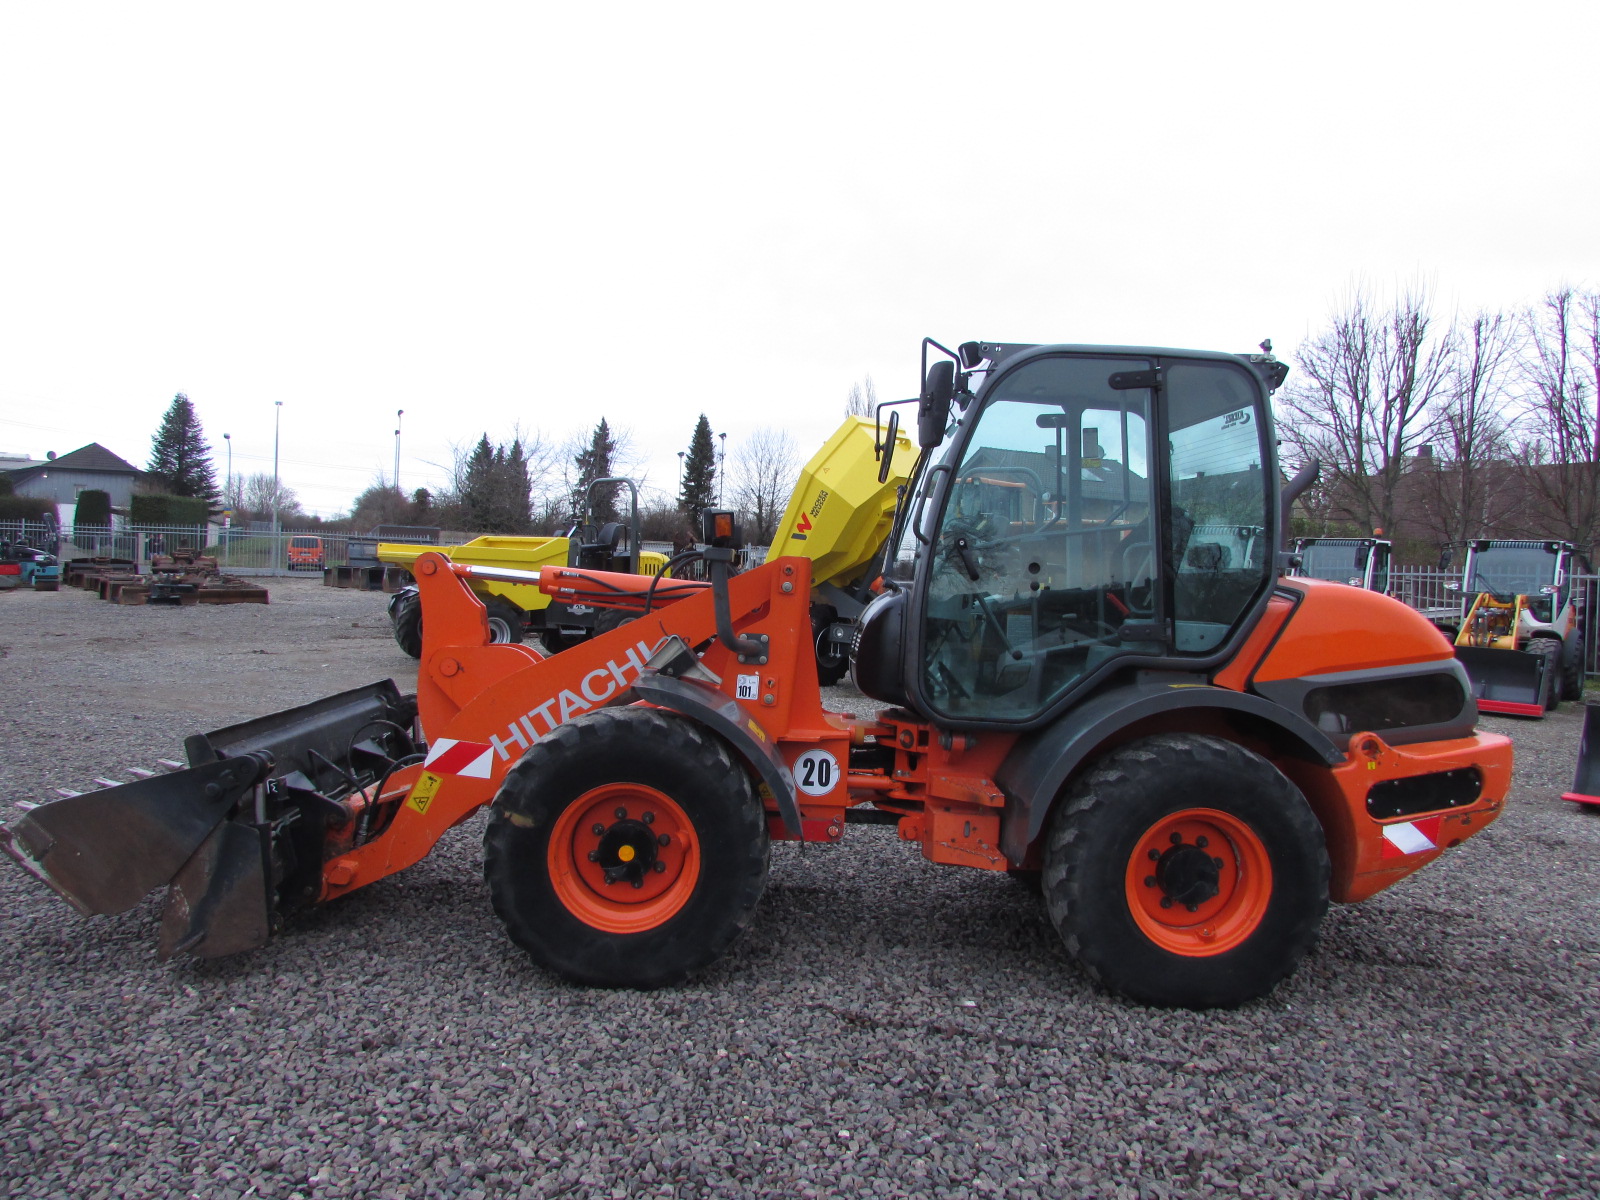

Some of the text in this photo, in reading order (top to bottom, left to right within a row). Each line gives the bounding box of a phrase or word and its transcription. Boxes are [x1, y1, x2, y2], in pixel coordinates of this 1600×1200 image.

[489, 640, 653, 761] HITACHI
[738, 685, 752, 698] 101
[802, 757, 831, 787] 20
